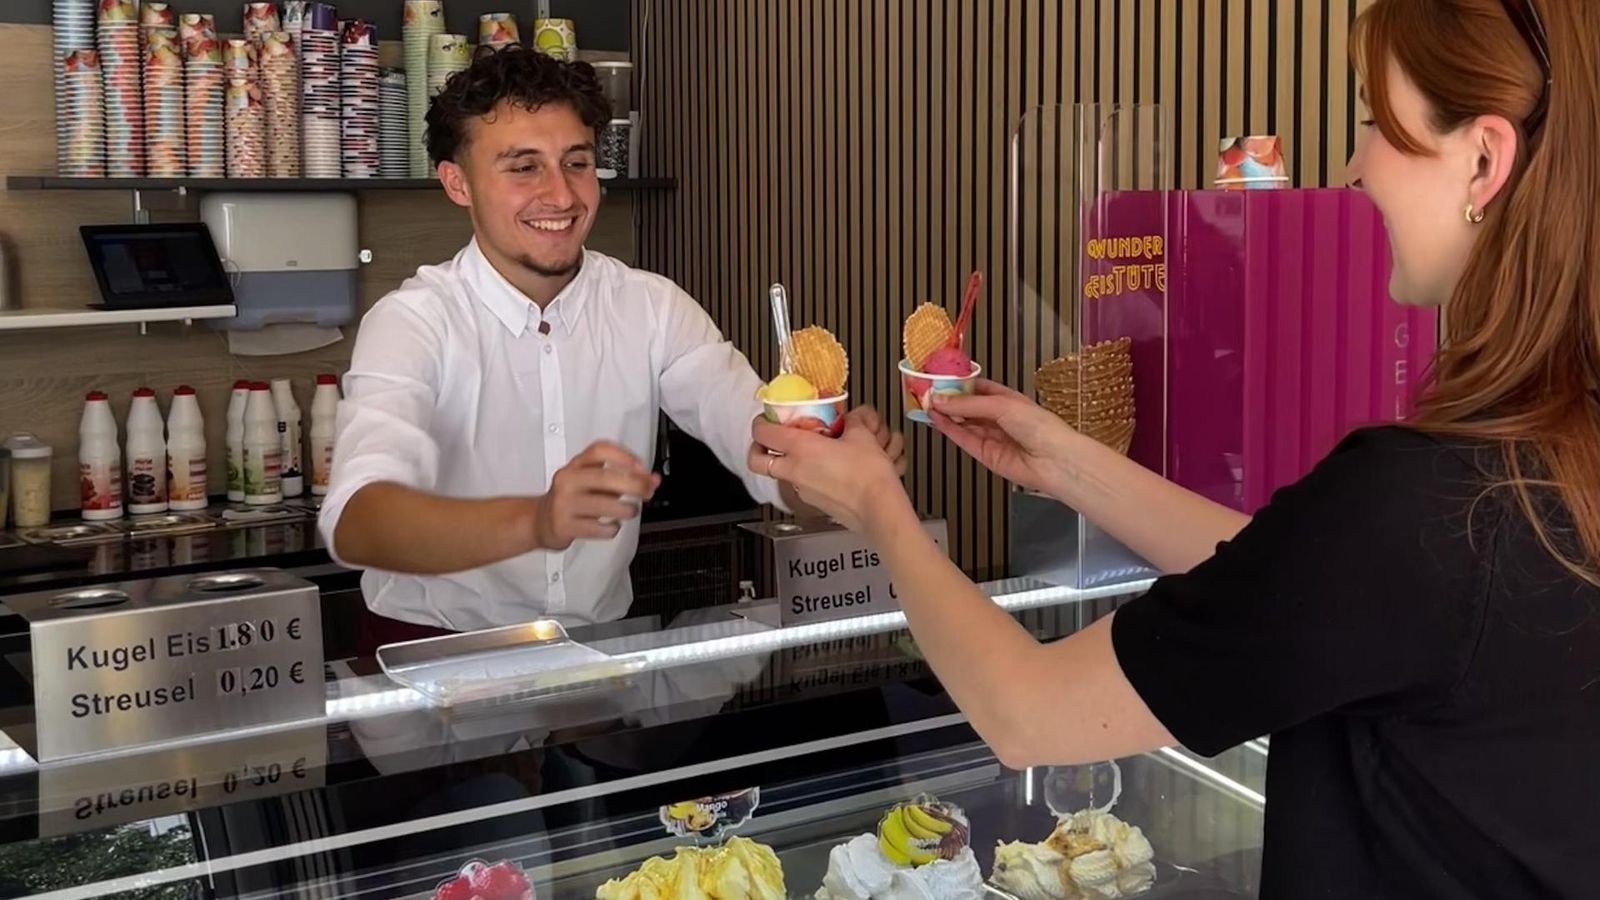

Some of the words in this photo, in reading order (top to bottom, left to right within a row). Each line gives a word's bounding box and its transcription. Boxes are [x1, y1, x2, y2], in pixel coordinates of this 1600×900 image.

[1087, 235, 1164, 259] WUNDER
[788, 553, 845, 579] Kugel
[851, 549, 881, 569] Eis
[791, 585, 872, 615] Streusel
[67, 638, 155, 671] Kugel
[167, 633, 211, 657] Eis
[286, 618, 301, 640] €
[71, 678, 195, 718] Streusel
[220, 665, 279, 696] 0,20
[289, 661, 305, 684] €
